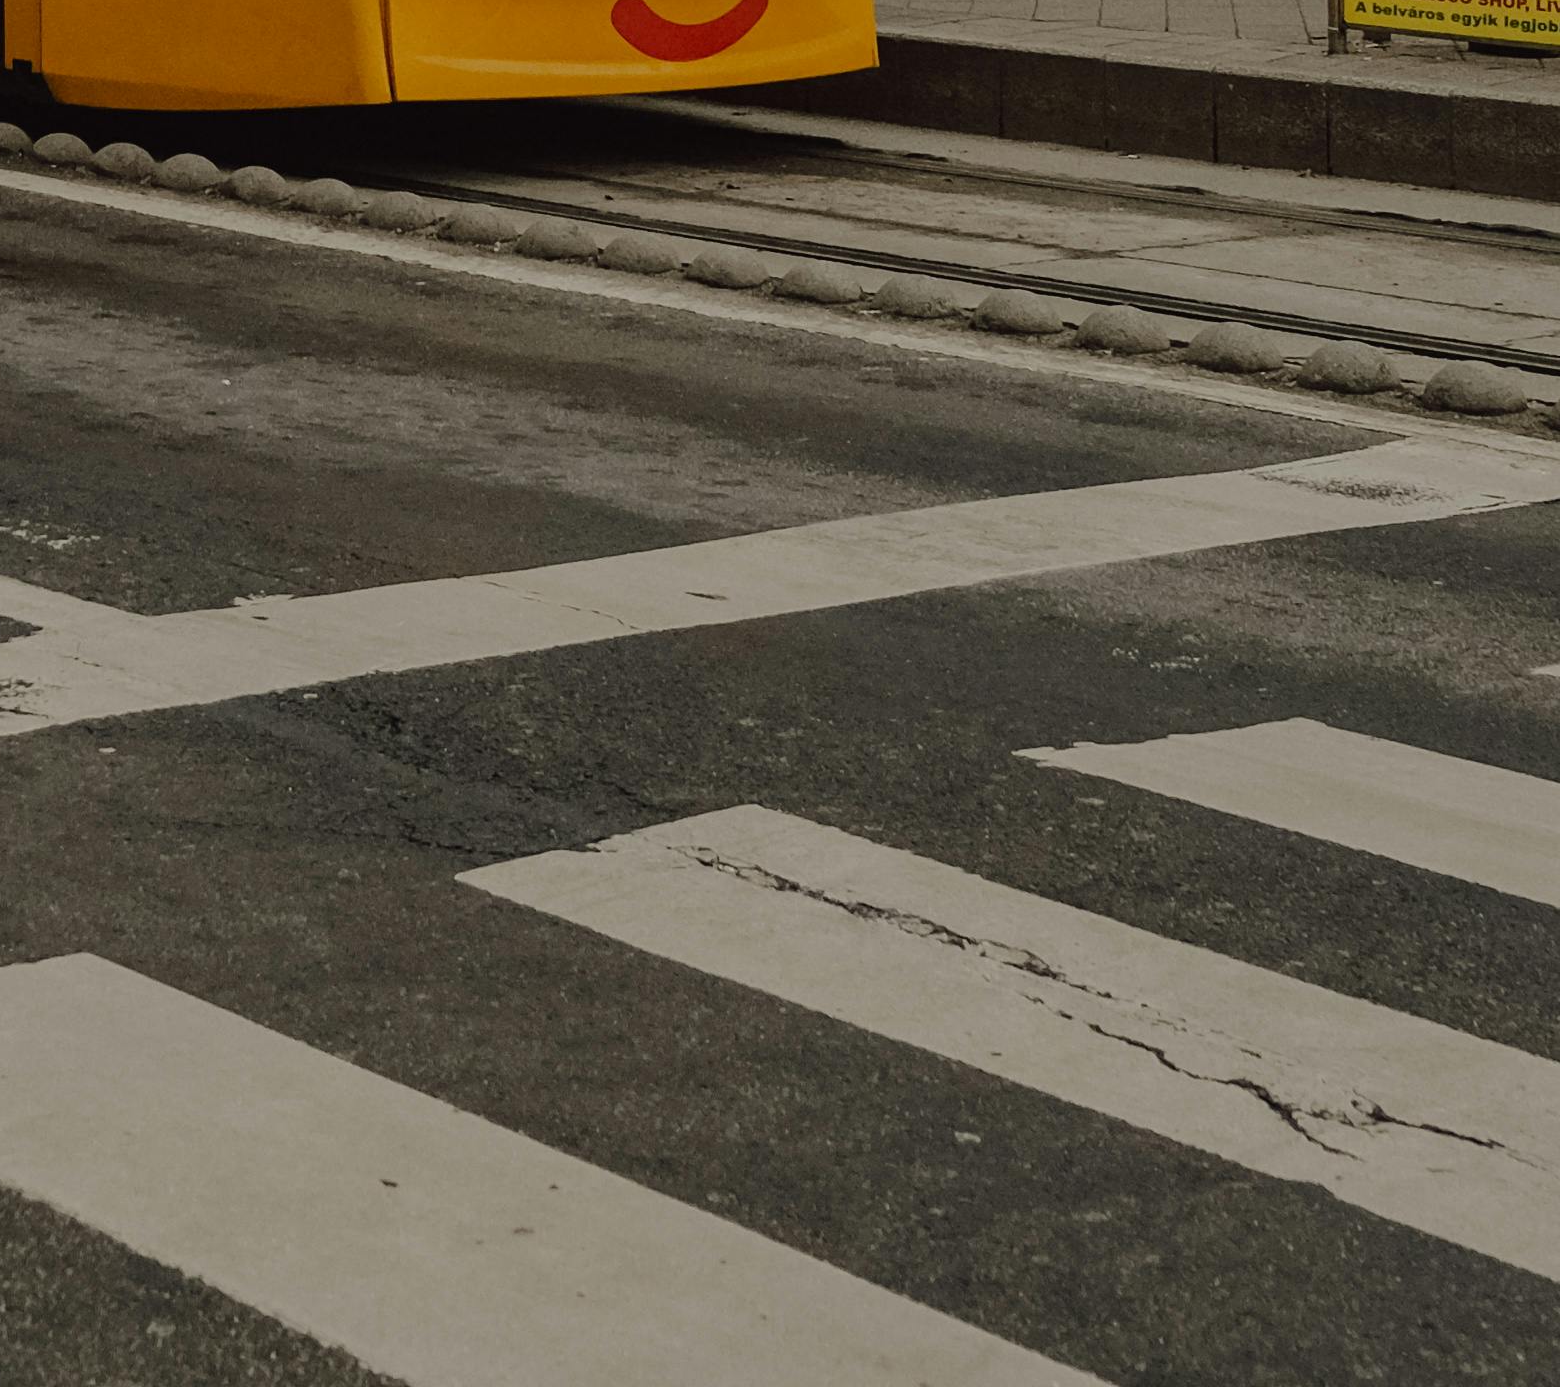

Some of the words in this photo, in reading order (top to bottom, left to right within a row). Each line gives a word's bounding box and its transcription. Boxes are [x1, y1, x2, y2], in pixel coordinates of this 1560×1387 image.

[1354, 1, 1367, 13] A
[1372, 2, 1446, 21] belváros
[1451, 12, 1498, 28] egyik
